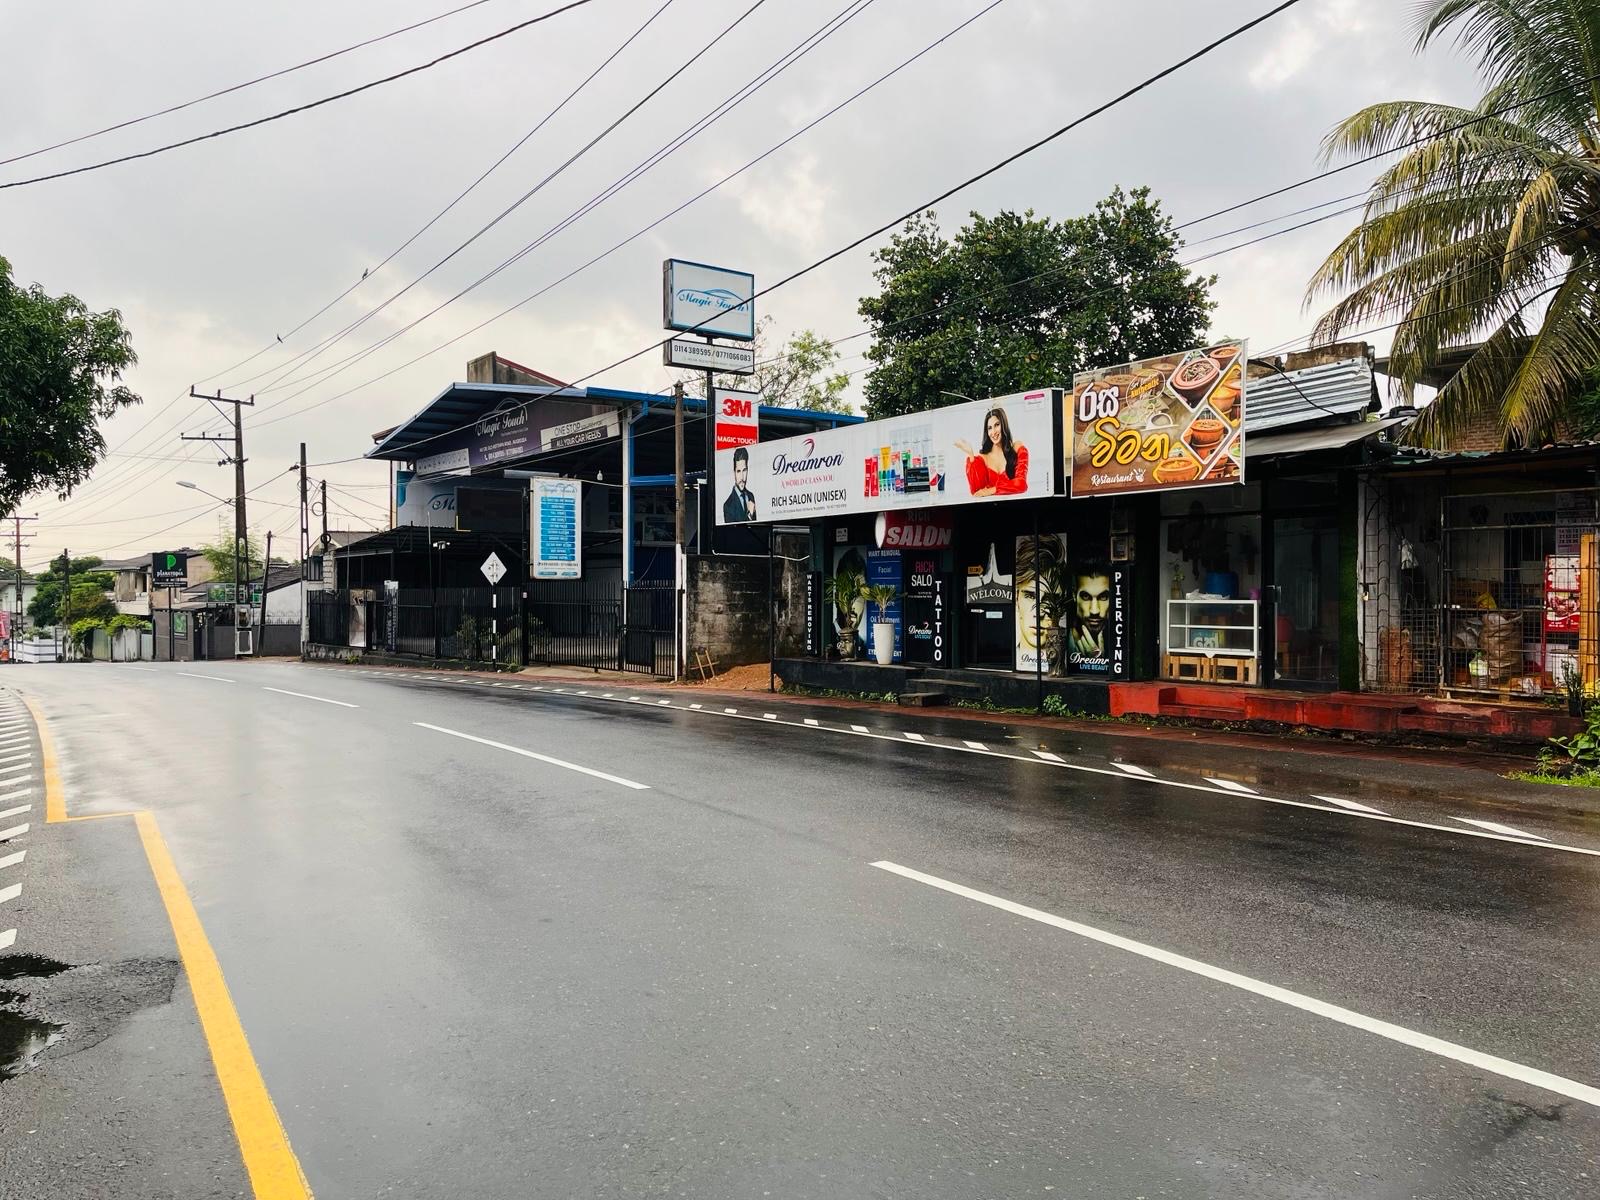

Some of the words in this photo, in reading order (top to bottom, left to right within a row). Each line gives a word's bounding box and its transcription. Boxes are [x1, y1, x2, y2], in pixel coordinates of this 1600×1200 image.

[678, 293, 711, 307] Magic
[722, 398, 752, 418] 3M
[1079, 382, 1120, 422] රස
[476, 417, 501, 437] Magic
[502, 410, 525, 429] Touch
[717, 436, 737, 444] MAGIC
[772, 452, 845, 475] Dreamron
[1091, 471, 1134, 486] Restaurant
[771, 496, 787, 507] RICH
[789, 493, 812, 505] SALON
[814, 488, 847, 504] (UNISEX)
[886, 525, 951, 546] SALON
[915, 561, 934, 573] RICH
[911, 574, 932, 587] SALO
[970, 589, 1013, 601] WELCOM
[934, 580, 942, 661] TATTOO
[1114, 572, 1123, 673] PIERCING
